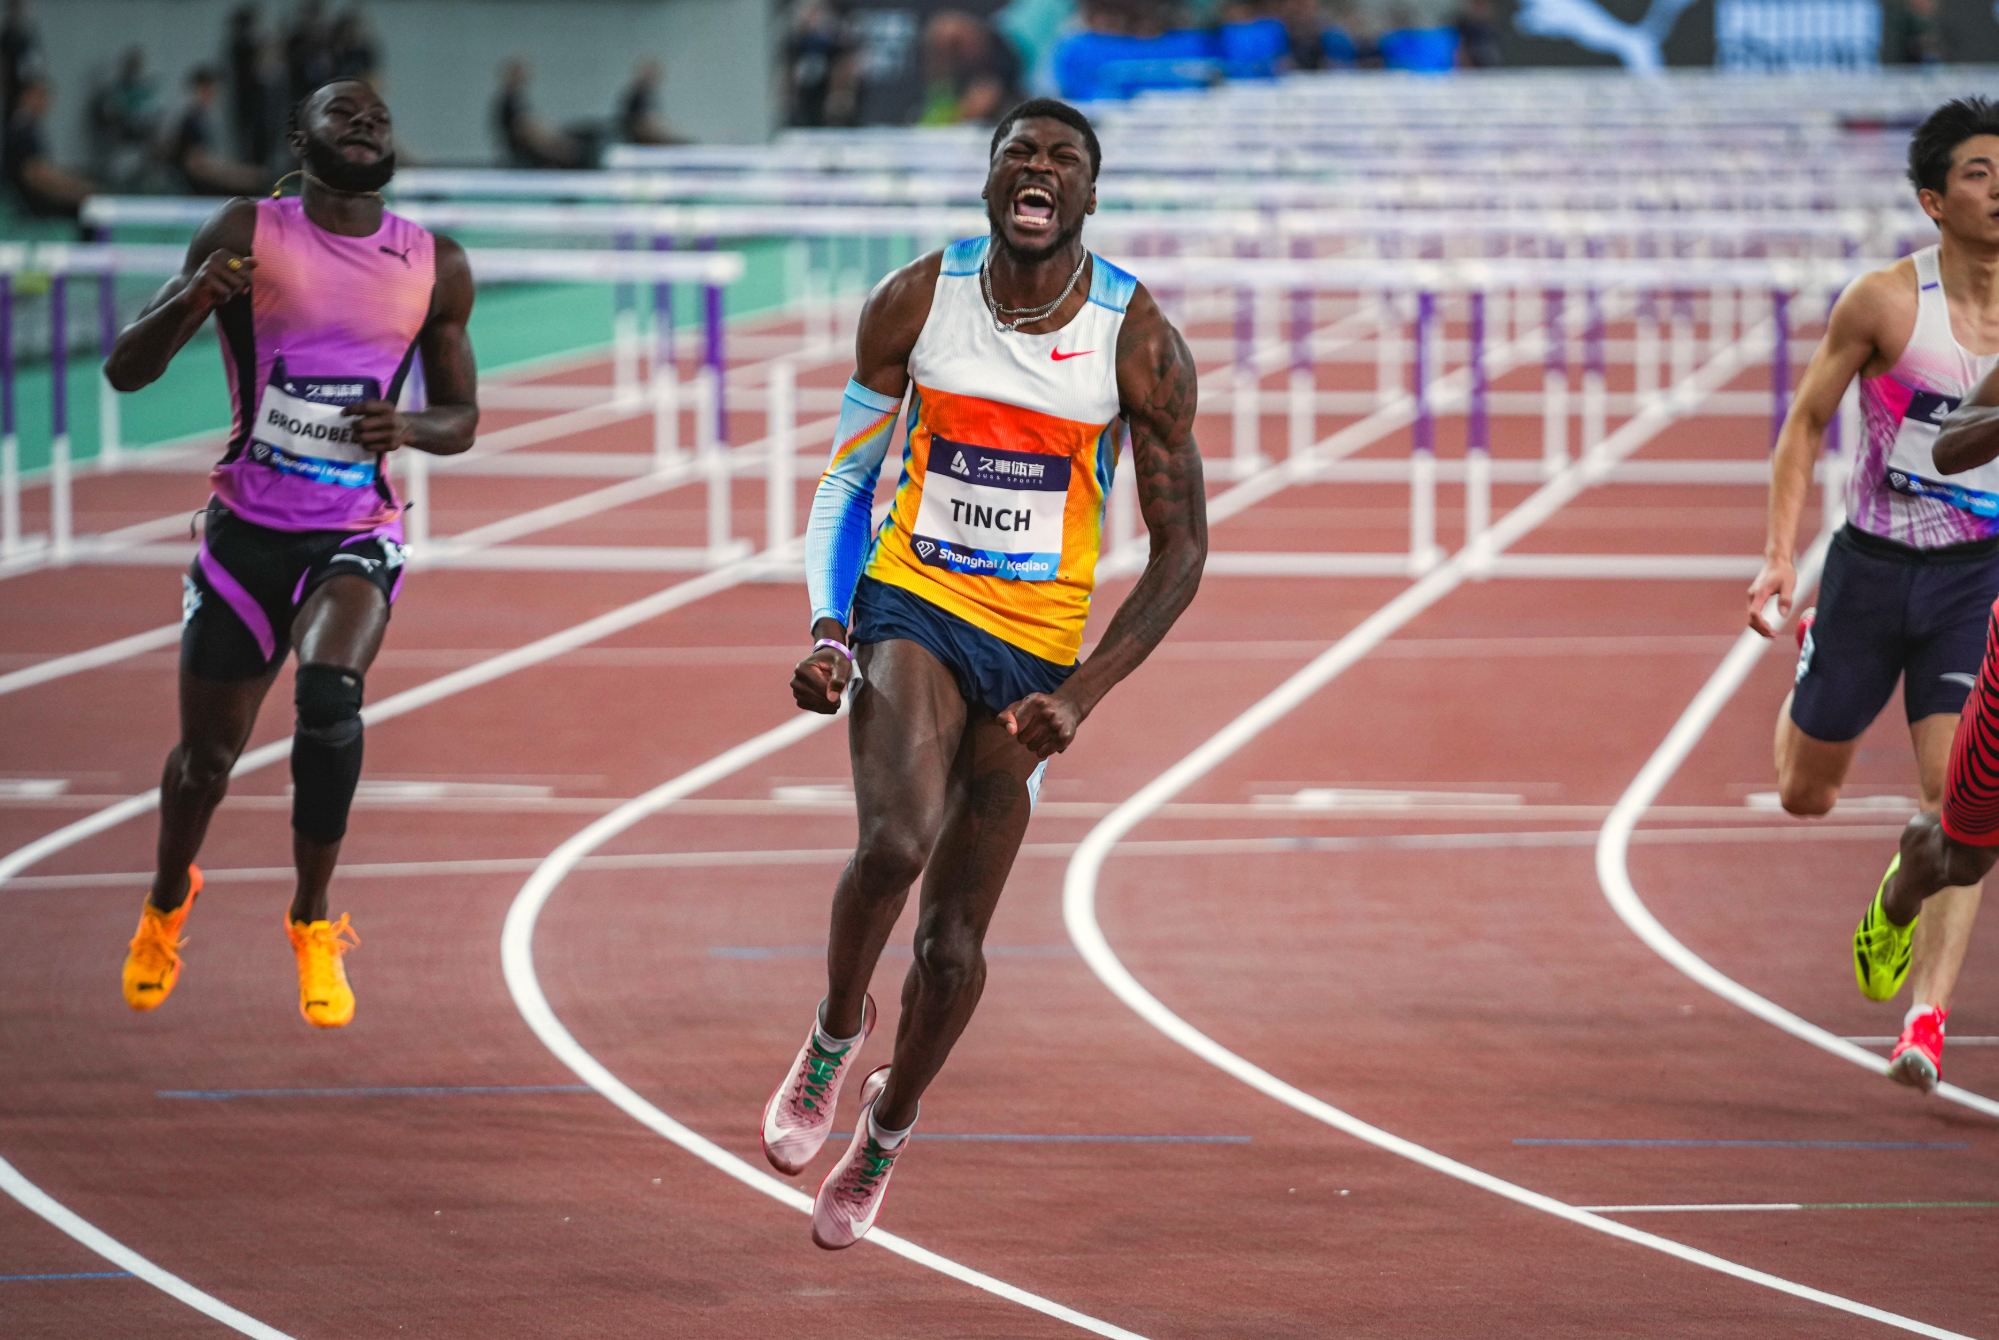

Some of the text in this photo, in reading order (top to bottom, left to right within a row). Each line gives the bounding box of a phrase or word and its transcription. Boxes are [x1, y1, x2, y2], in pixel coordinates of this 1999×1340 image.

[977, 456, 1045, 478] 久事体育
[976, 473, 1043, 485] JUSS SPORTS
[950, 498, 1032, 532] TINCH
[939, 548, 998, 569] Shanghai
[1006, 560, 1049, 572] Keqiao
